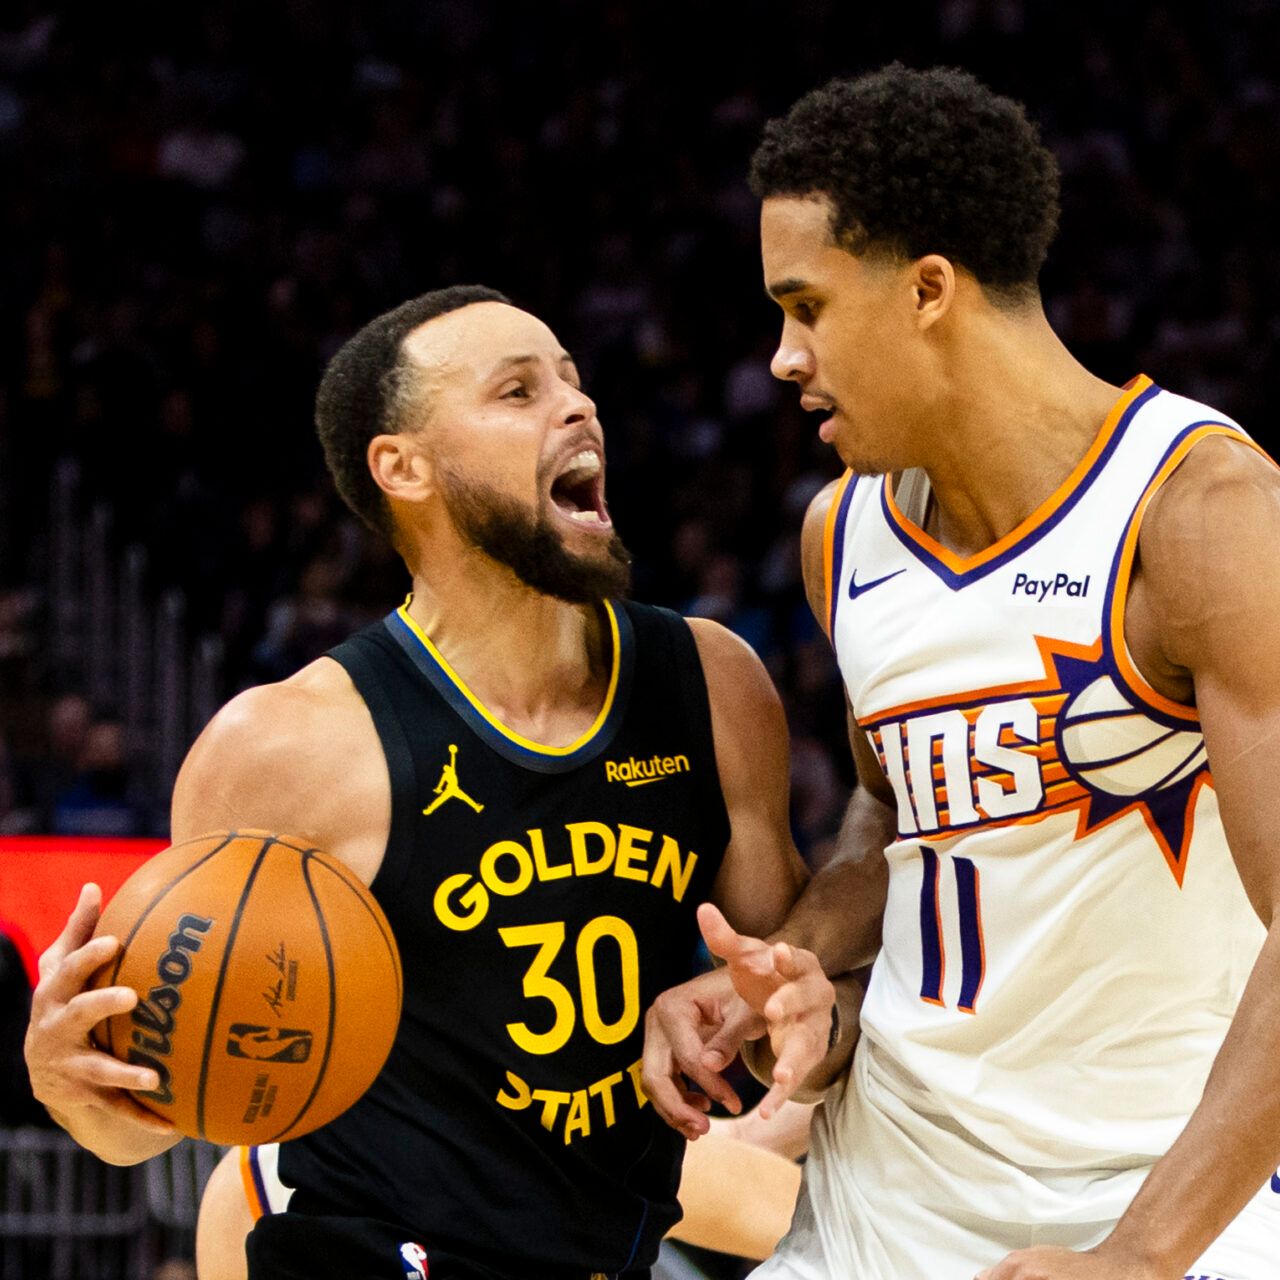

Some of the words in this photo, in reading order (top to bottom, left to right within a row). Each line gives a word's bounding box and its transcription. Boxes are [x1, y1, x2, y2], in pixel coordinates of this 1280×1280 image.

[1012, 573, 1091, 603] PayPal
[605, 754, 690, 783] Rakuten
[433, 821, 698, 931] GOLDEN
[919, 845, 986, 1014] 11
[497, 915, 640, 1055] 30
